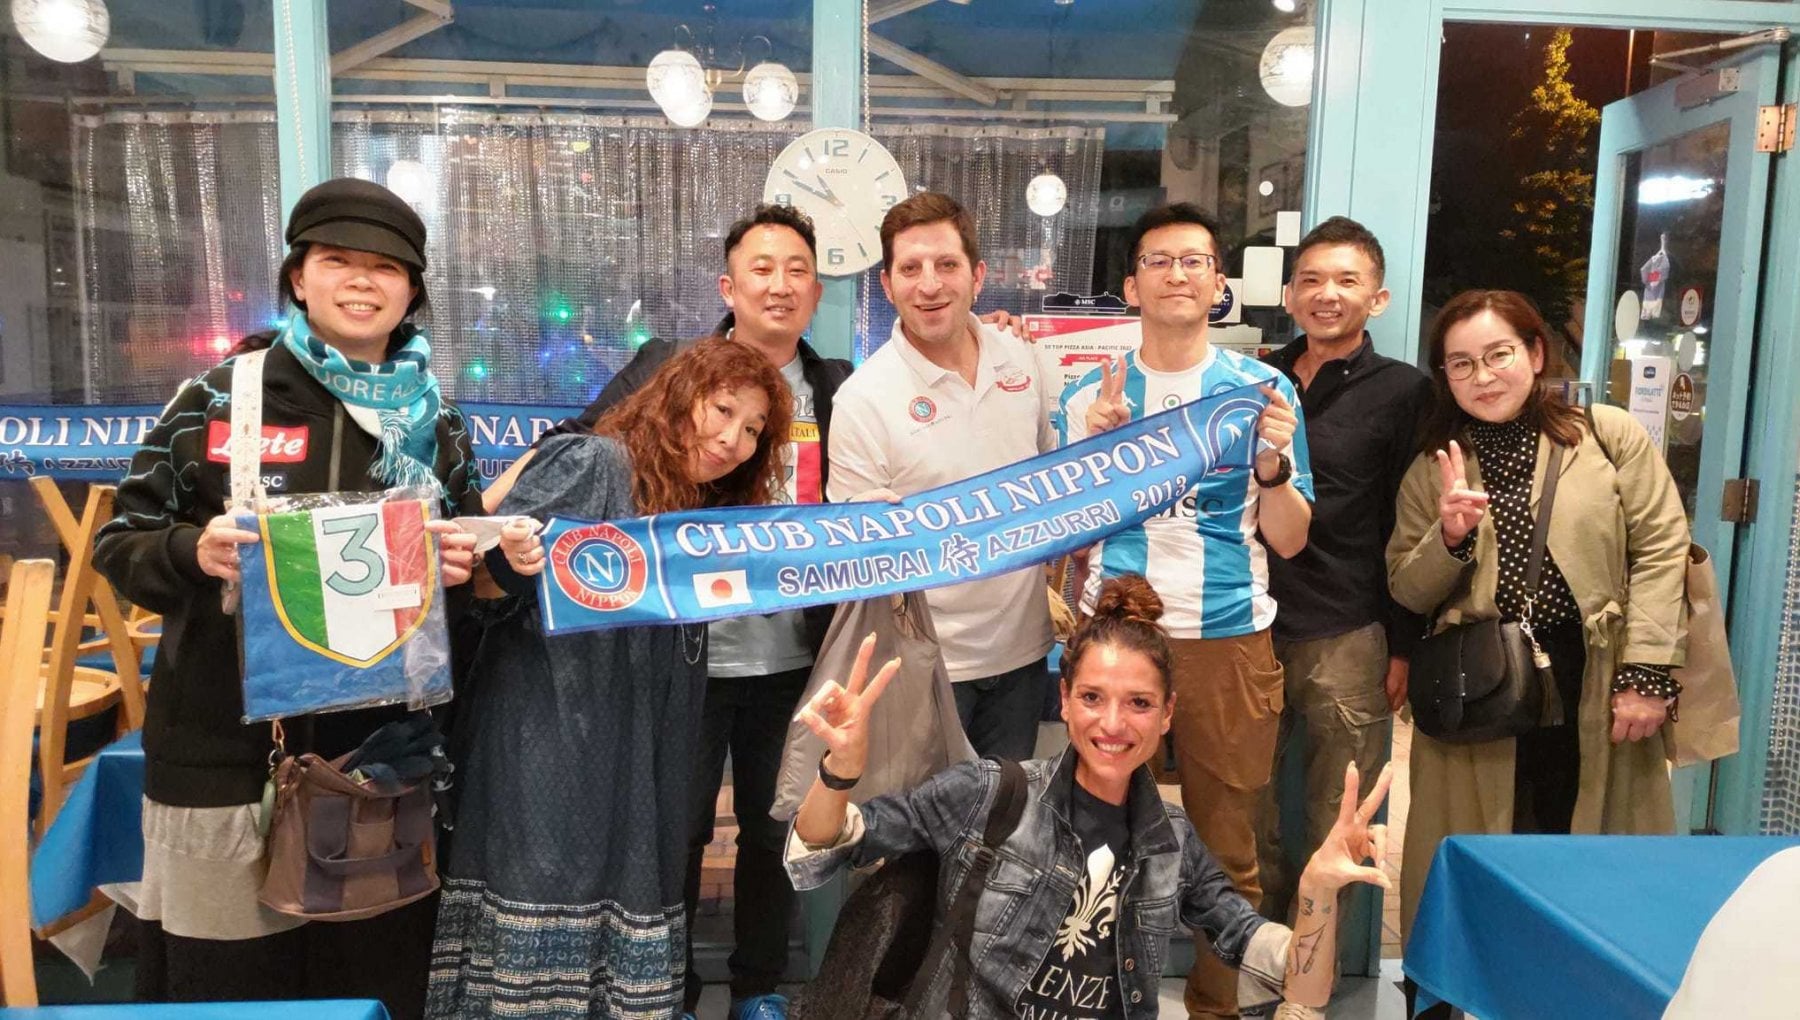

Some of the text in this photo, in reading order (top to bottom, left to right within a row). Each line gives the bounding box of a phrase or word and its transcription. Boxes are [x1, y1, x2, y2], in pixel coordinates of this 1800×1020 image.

[824, 139, 849, 157] 12
[827, 248, 845, 265] 6
[470, 415, 566, 447] NAP
[676, 426, 1182, 557] CLUB NAPOLI NIPPON
[554, 525, 642, 565] CLUB NAPOLI
[778, 475, 1188, 597] SAMURAI 侍 AZZURRI 2013
[322, 513, 385, 596] 3
[581, 551, 616, 583] N
